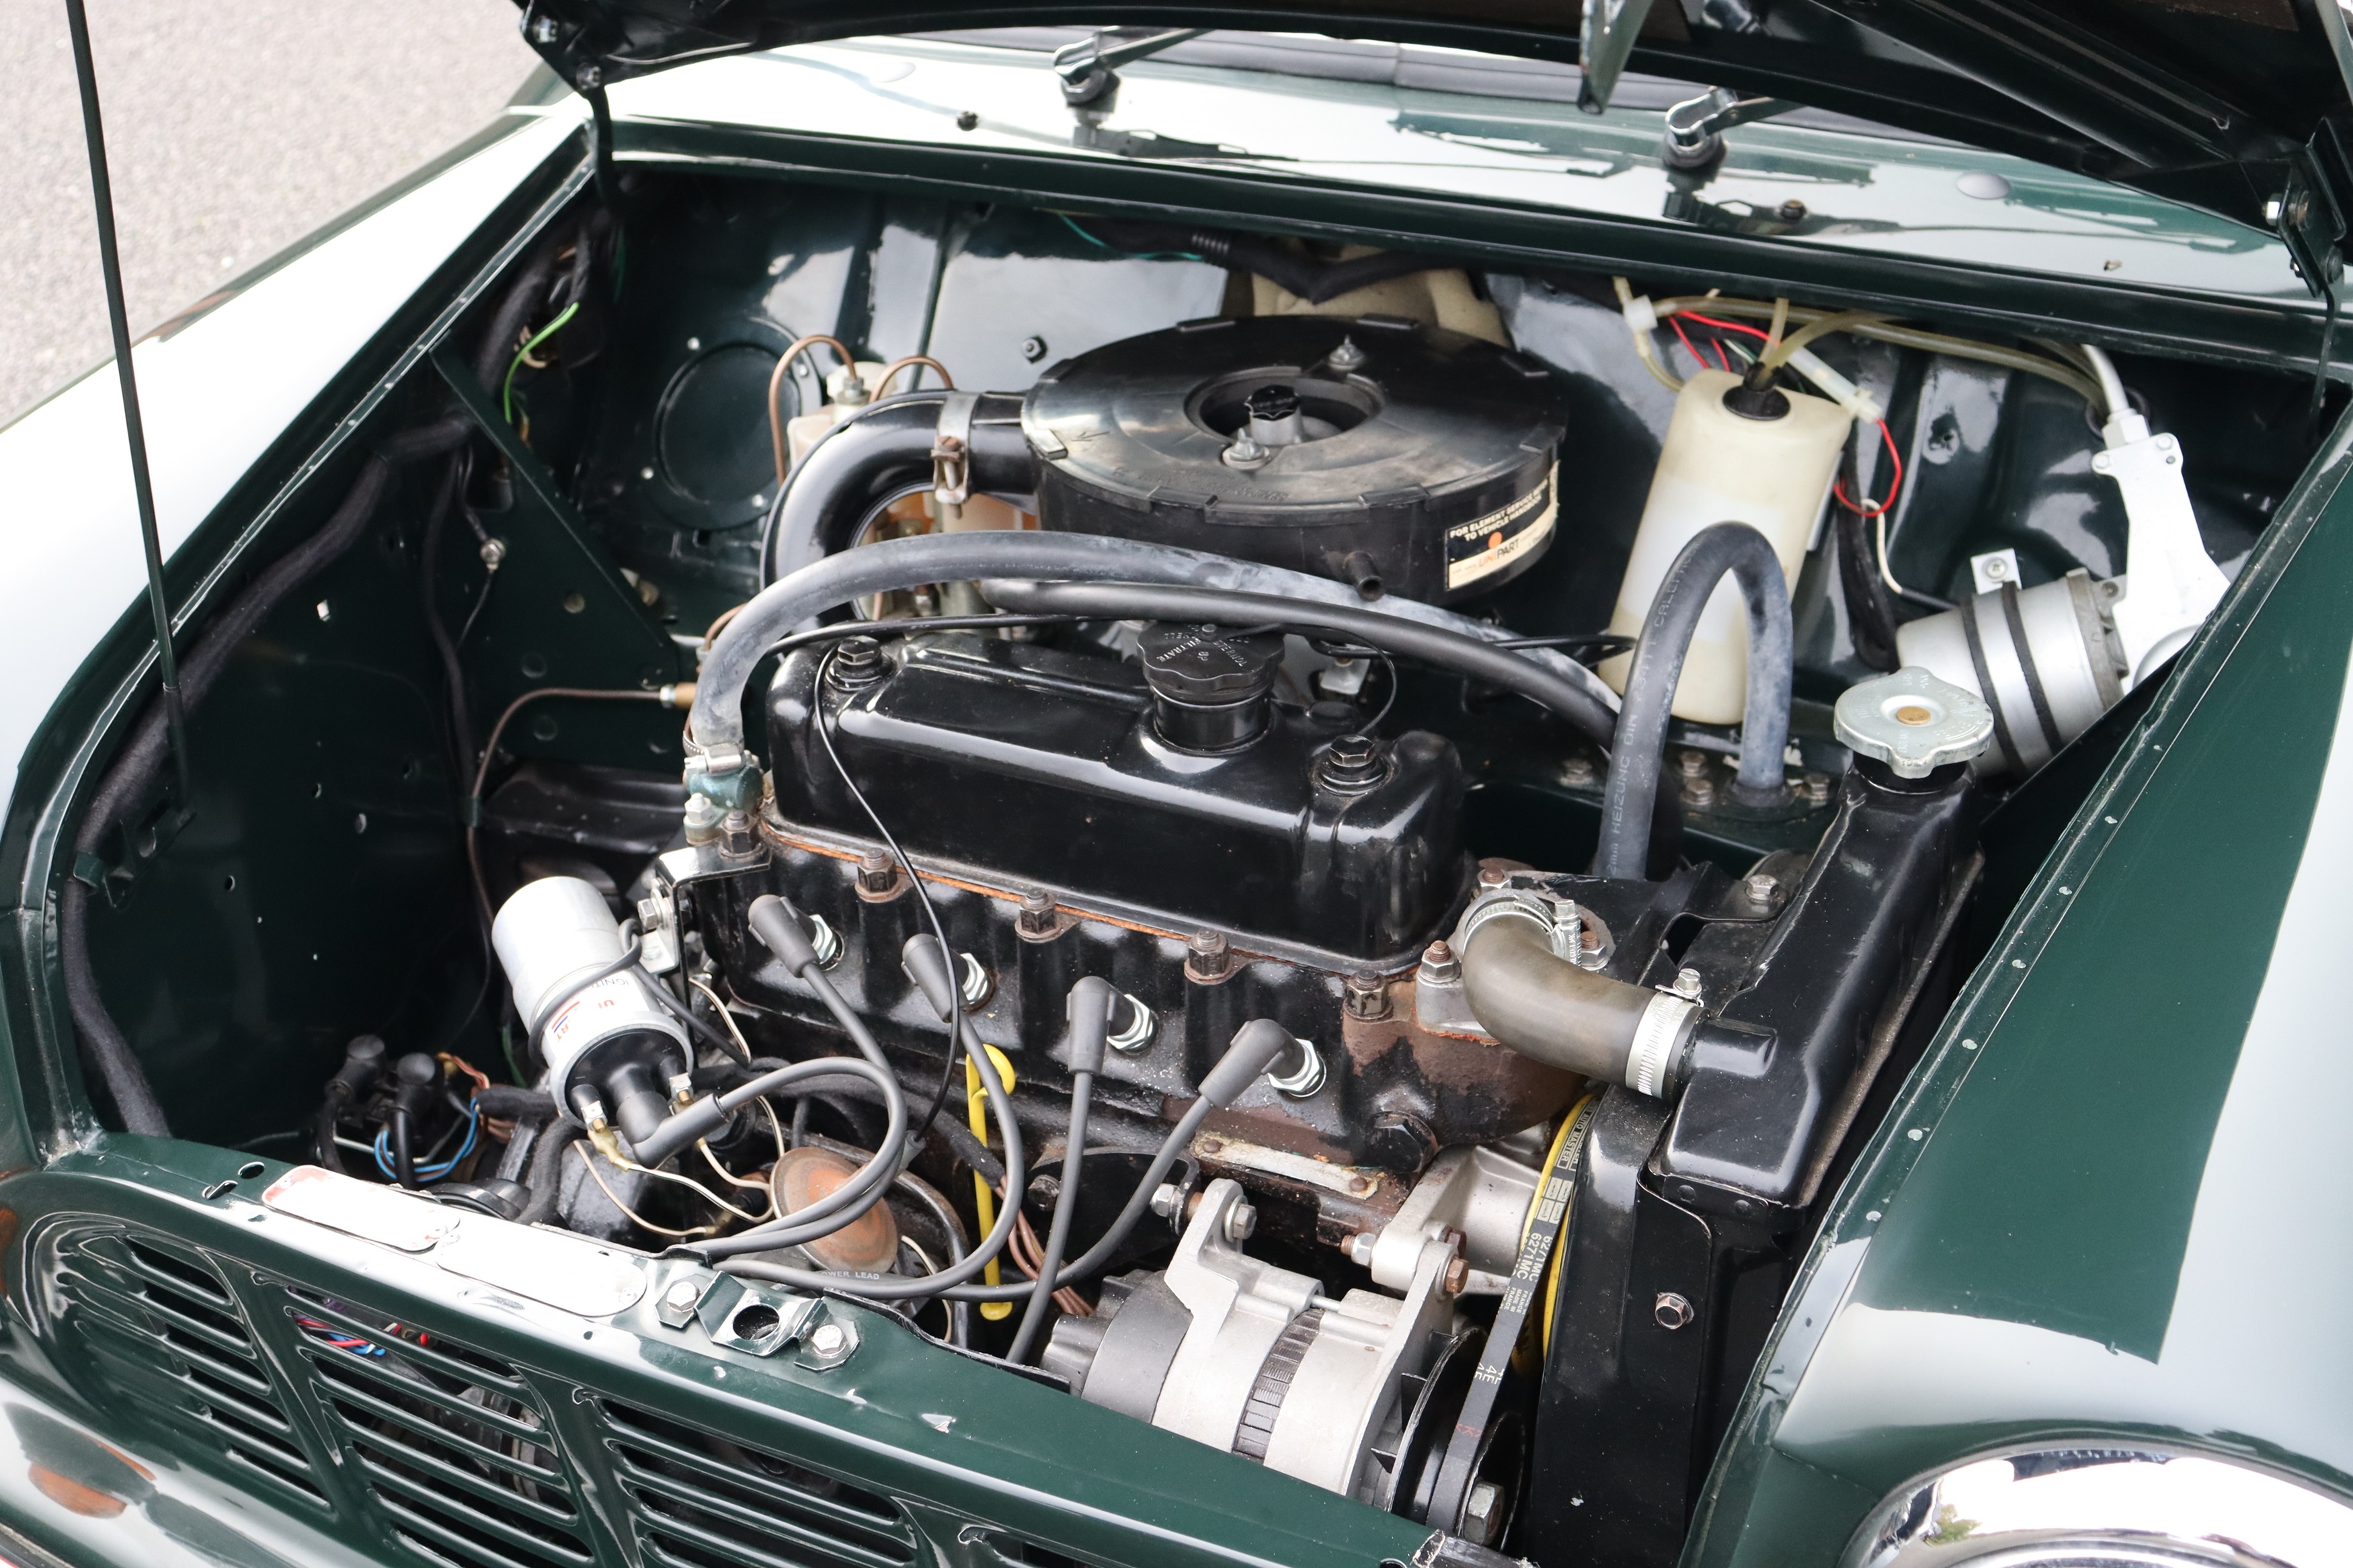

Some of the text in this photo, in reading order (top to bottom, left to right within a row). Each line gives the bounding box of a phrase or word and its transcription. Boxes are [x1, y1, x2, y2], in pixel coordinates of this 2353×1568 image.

[1449, 526, 1469, 539] FOR
[1470, 509, 1505, 532] ELEMENT
[1506, 493, 1534, 515] SERVICE
[1464, 531, 1478, 542] TO
[1478, 517, 1510, 536] VEHICLE
[1478, 538, 1520, 568] UNIPART
[1156, 637, 1201, 662] FILTRATE
[1611, 755, 1632, 834] HEIZUNG
[1624, 714, 1638, 745] DIN
[1576, 1114, 1590, 1130] AUTO
[1561, 1130, 1581, 1163] MASTER
[1517, 1232, 1543, 1280] 6271MC
[855, 1272, 880, 1280] LEAD
[1503, 1287, 1517, 1311] FRANCE
[1513, 1288, 1523, 1304] MADE
[1516, 1290, 1528, 1314] FRANCE
[1482, 1364, 1497, 1383] 4E
